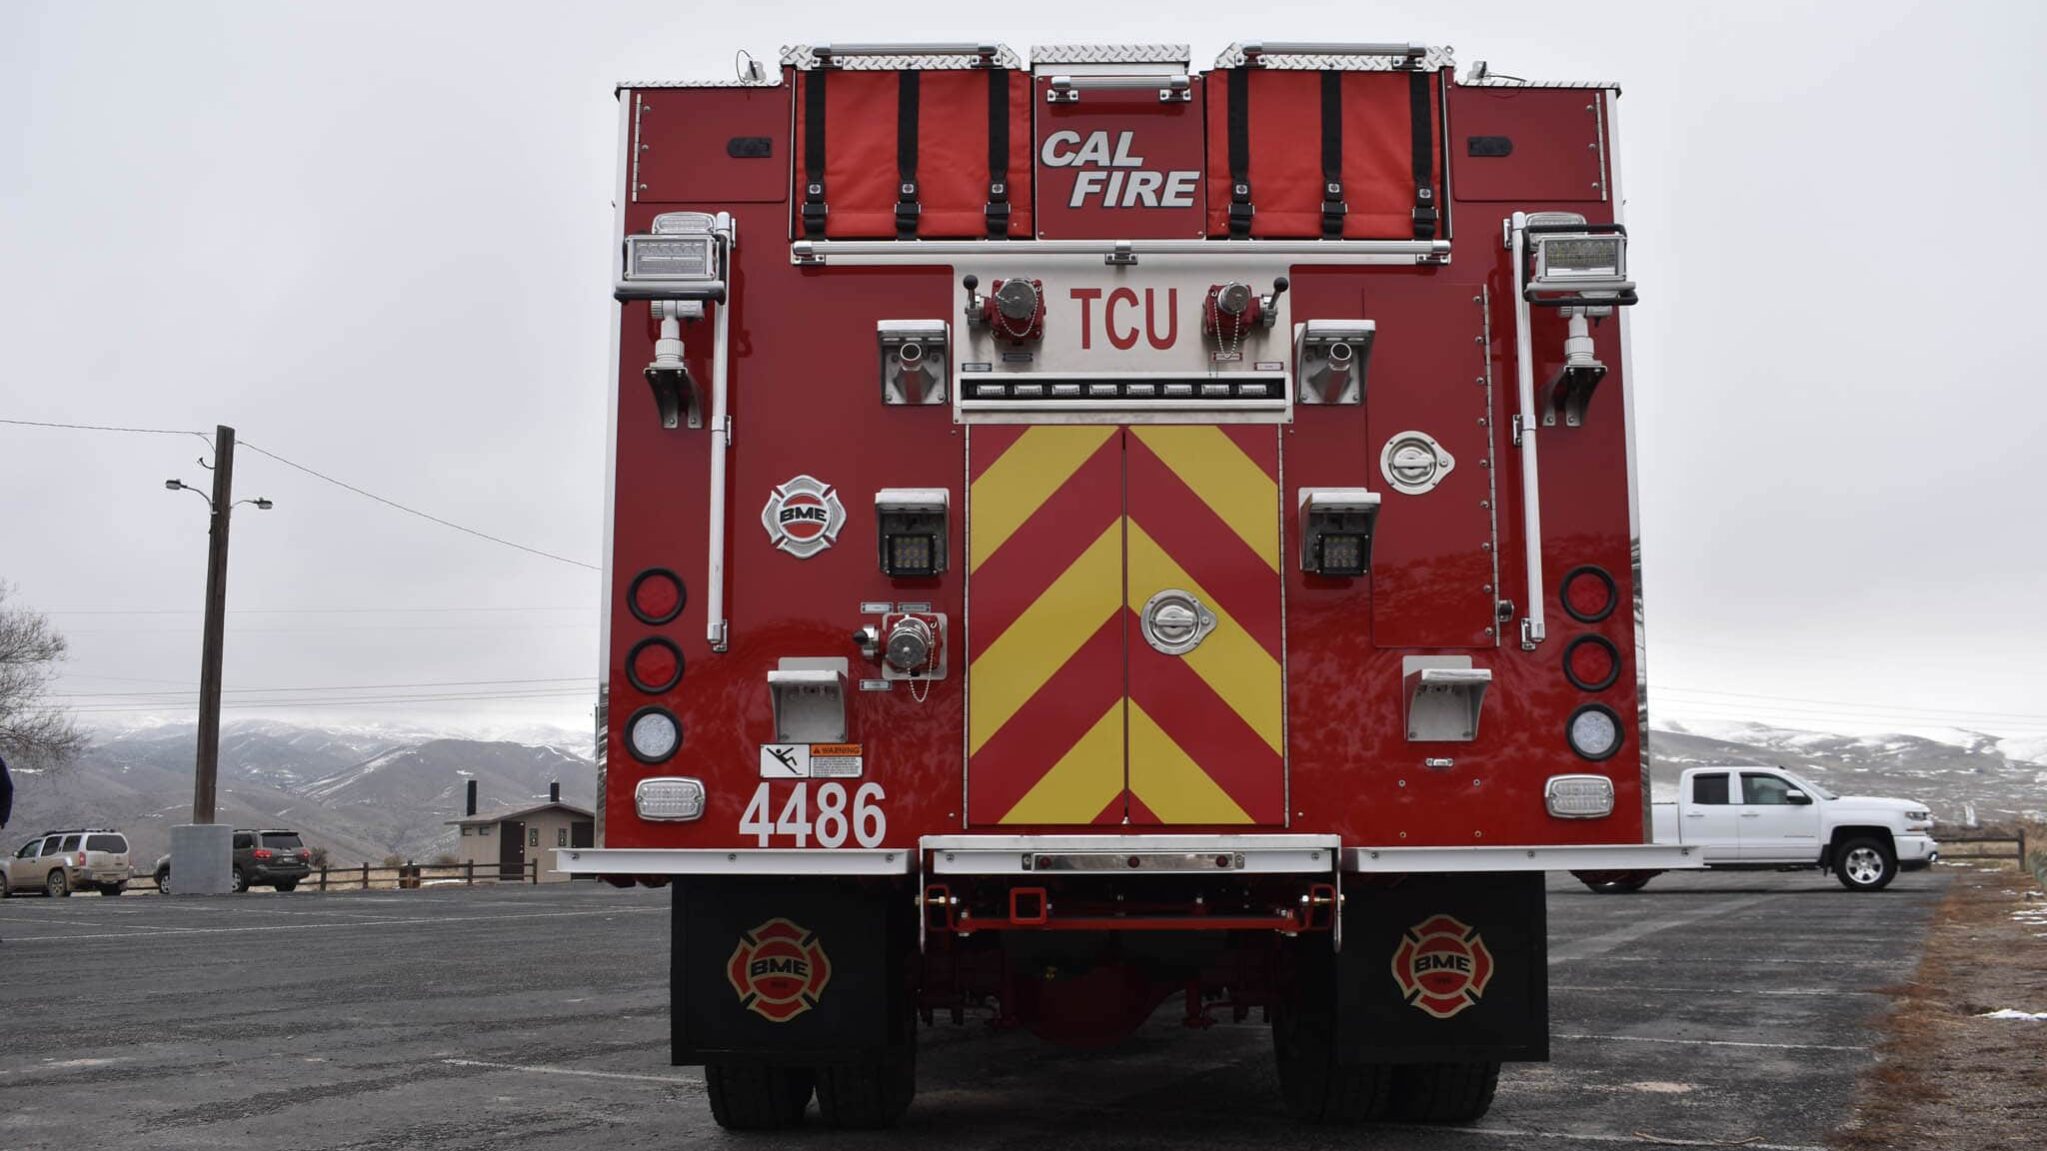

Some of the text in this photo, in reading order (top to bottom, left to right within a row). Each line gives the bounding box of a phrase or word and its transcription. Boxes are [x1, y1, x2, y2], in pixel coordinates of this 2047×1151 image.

[1041, 130, 1144, 167] CAL
[1069, 171, 1200, 207] FIRE
[1070, 287, 1178, 351] TCU
[780, 506, 827, 523] BME
[822, 745, 860, 754] WARNING
[738, 781, 887, 848] 4486
[751, 958, 809, 978] BME
[1414, 954, 1471, 974] BME
